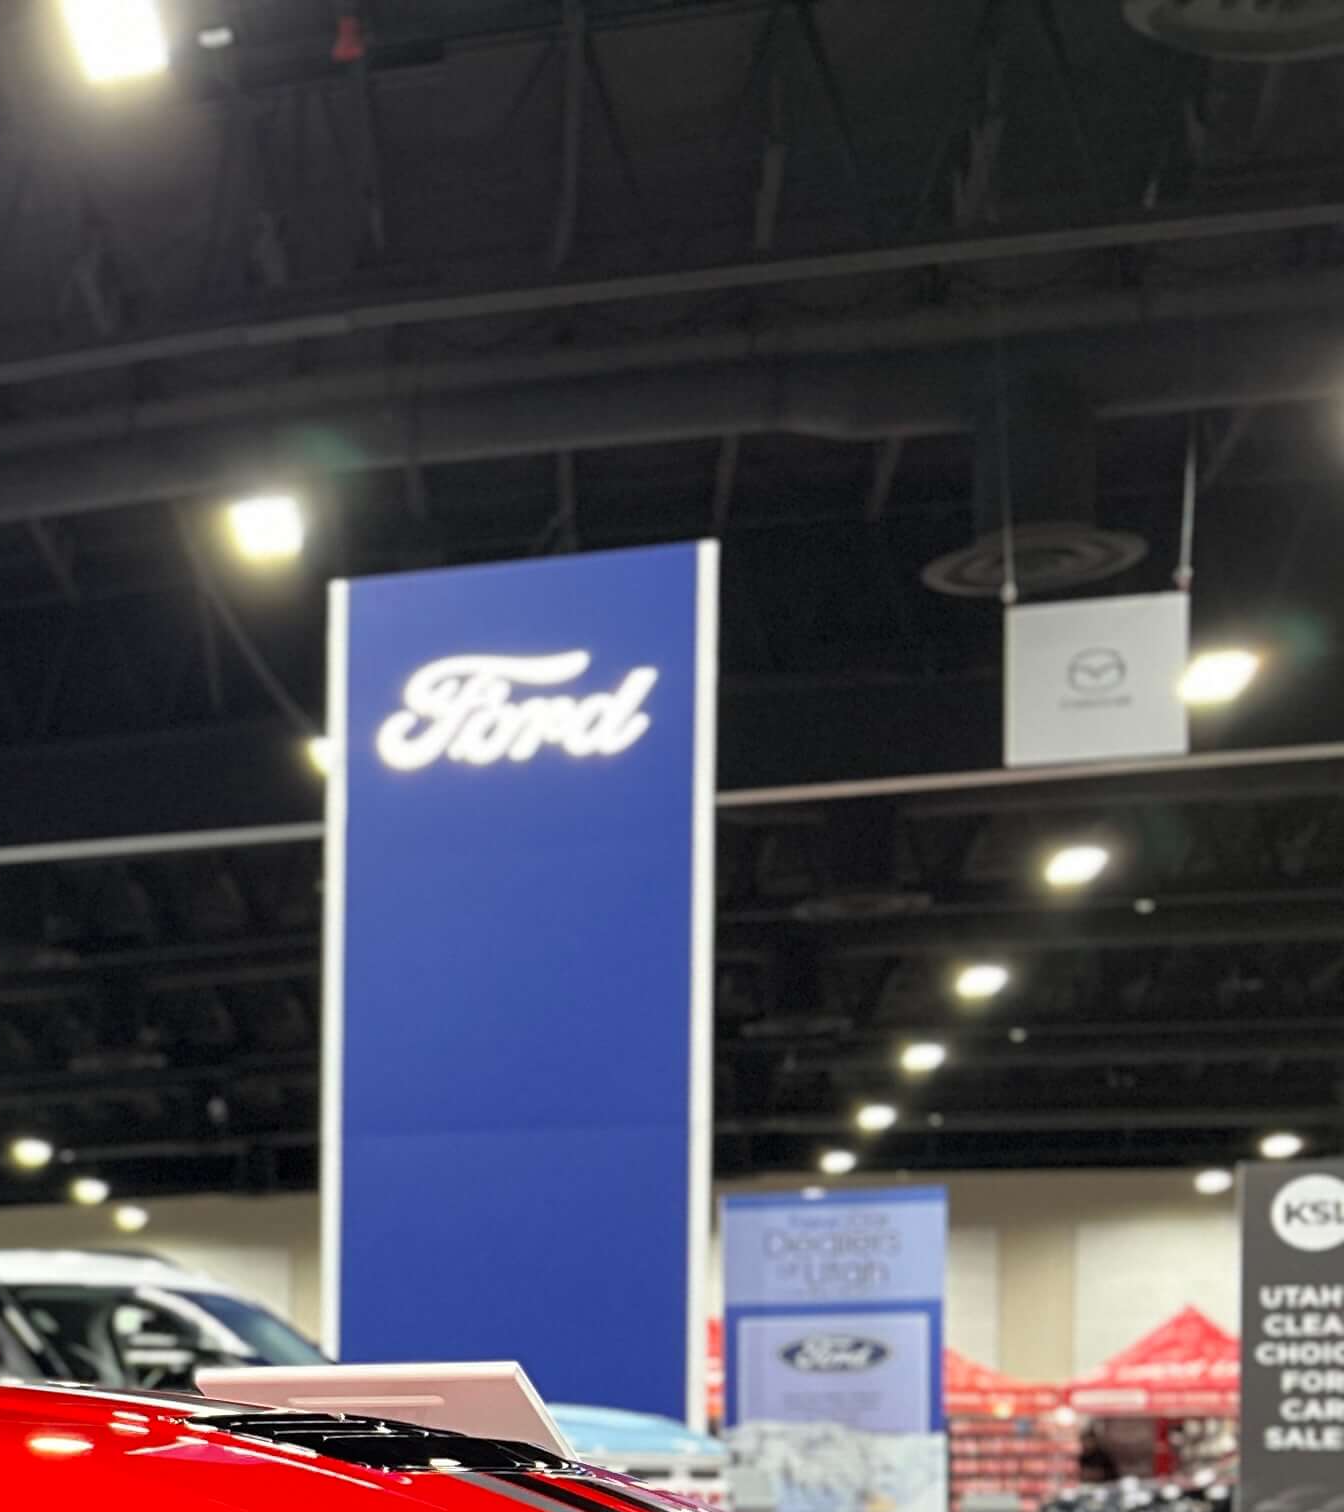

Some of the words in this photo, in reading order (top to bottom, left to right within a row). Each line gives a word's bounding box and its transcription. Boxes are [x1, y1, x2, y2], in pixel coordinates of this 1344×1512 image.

[376, 650, 658, 771] Ford
[1284, 1201, 1344, 1225] KSL
[795, 1335, 873, 1370] Ford
